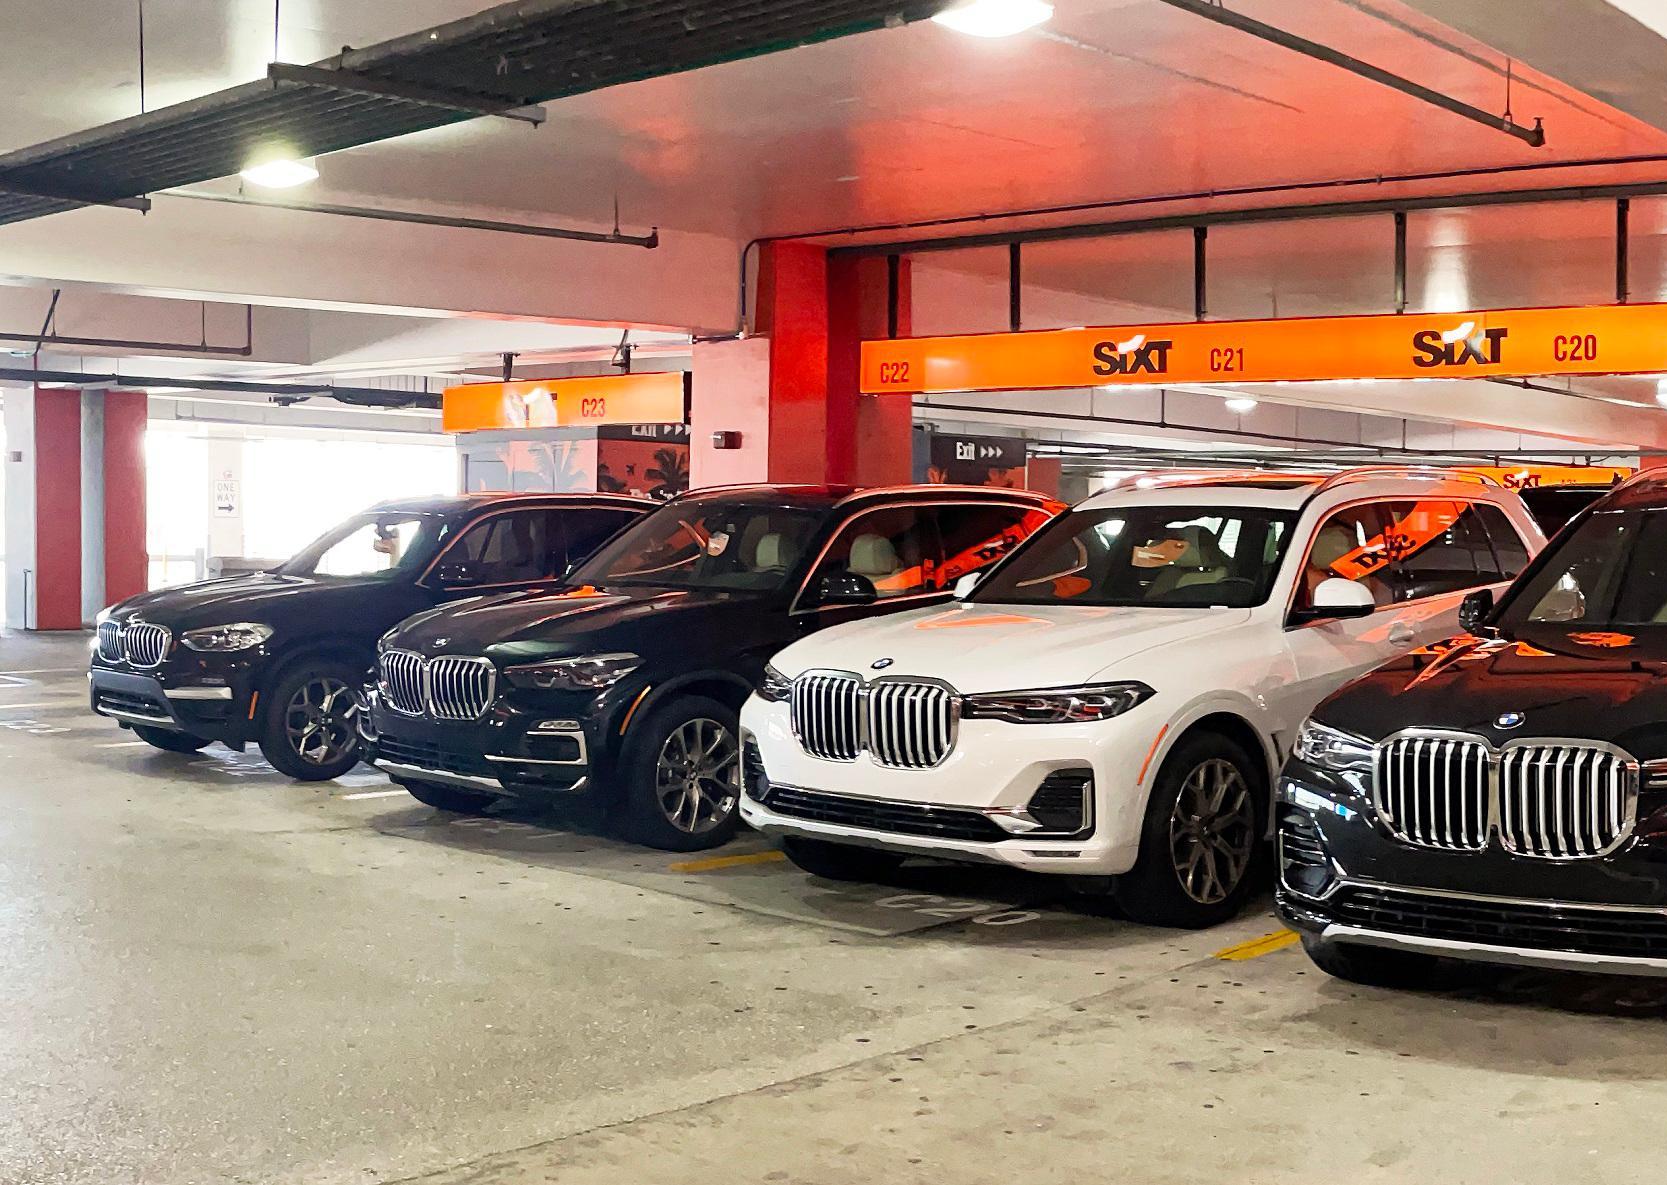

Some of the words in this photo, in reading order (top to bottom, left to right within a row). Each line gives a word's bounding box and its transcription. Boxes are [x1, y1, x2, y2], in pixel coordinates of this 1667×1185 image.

[1210, 348, 1245, 372] C21
[1554, 334, 1597, 361] C20
[880, 361, 909, 384] C22
[582, 398, 606, 418] C23
[217, 482, 236, 492] ONE
[217, 493, 236, 503] WAY
